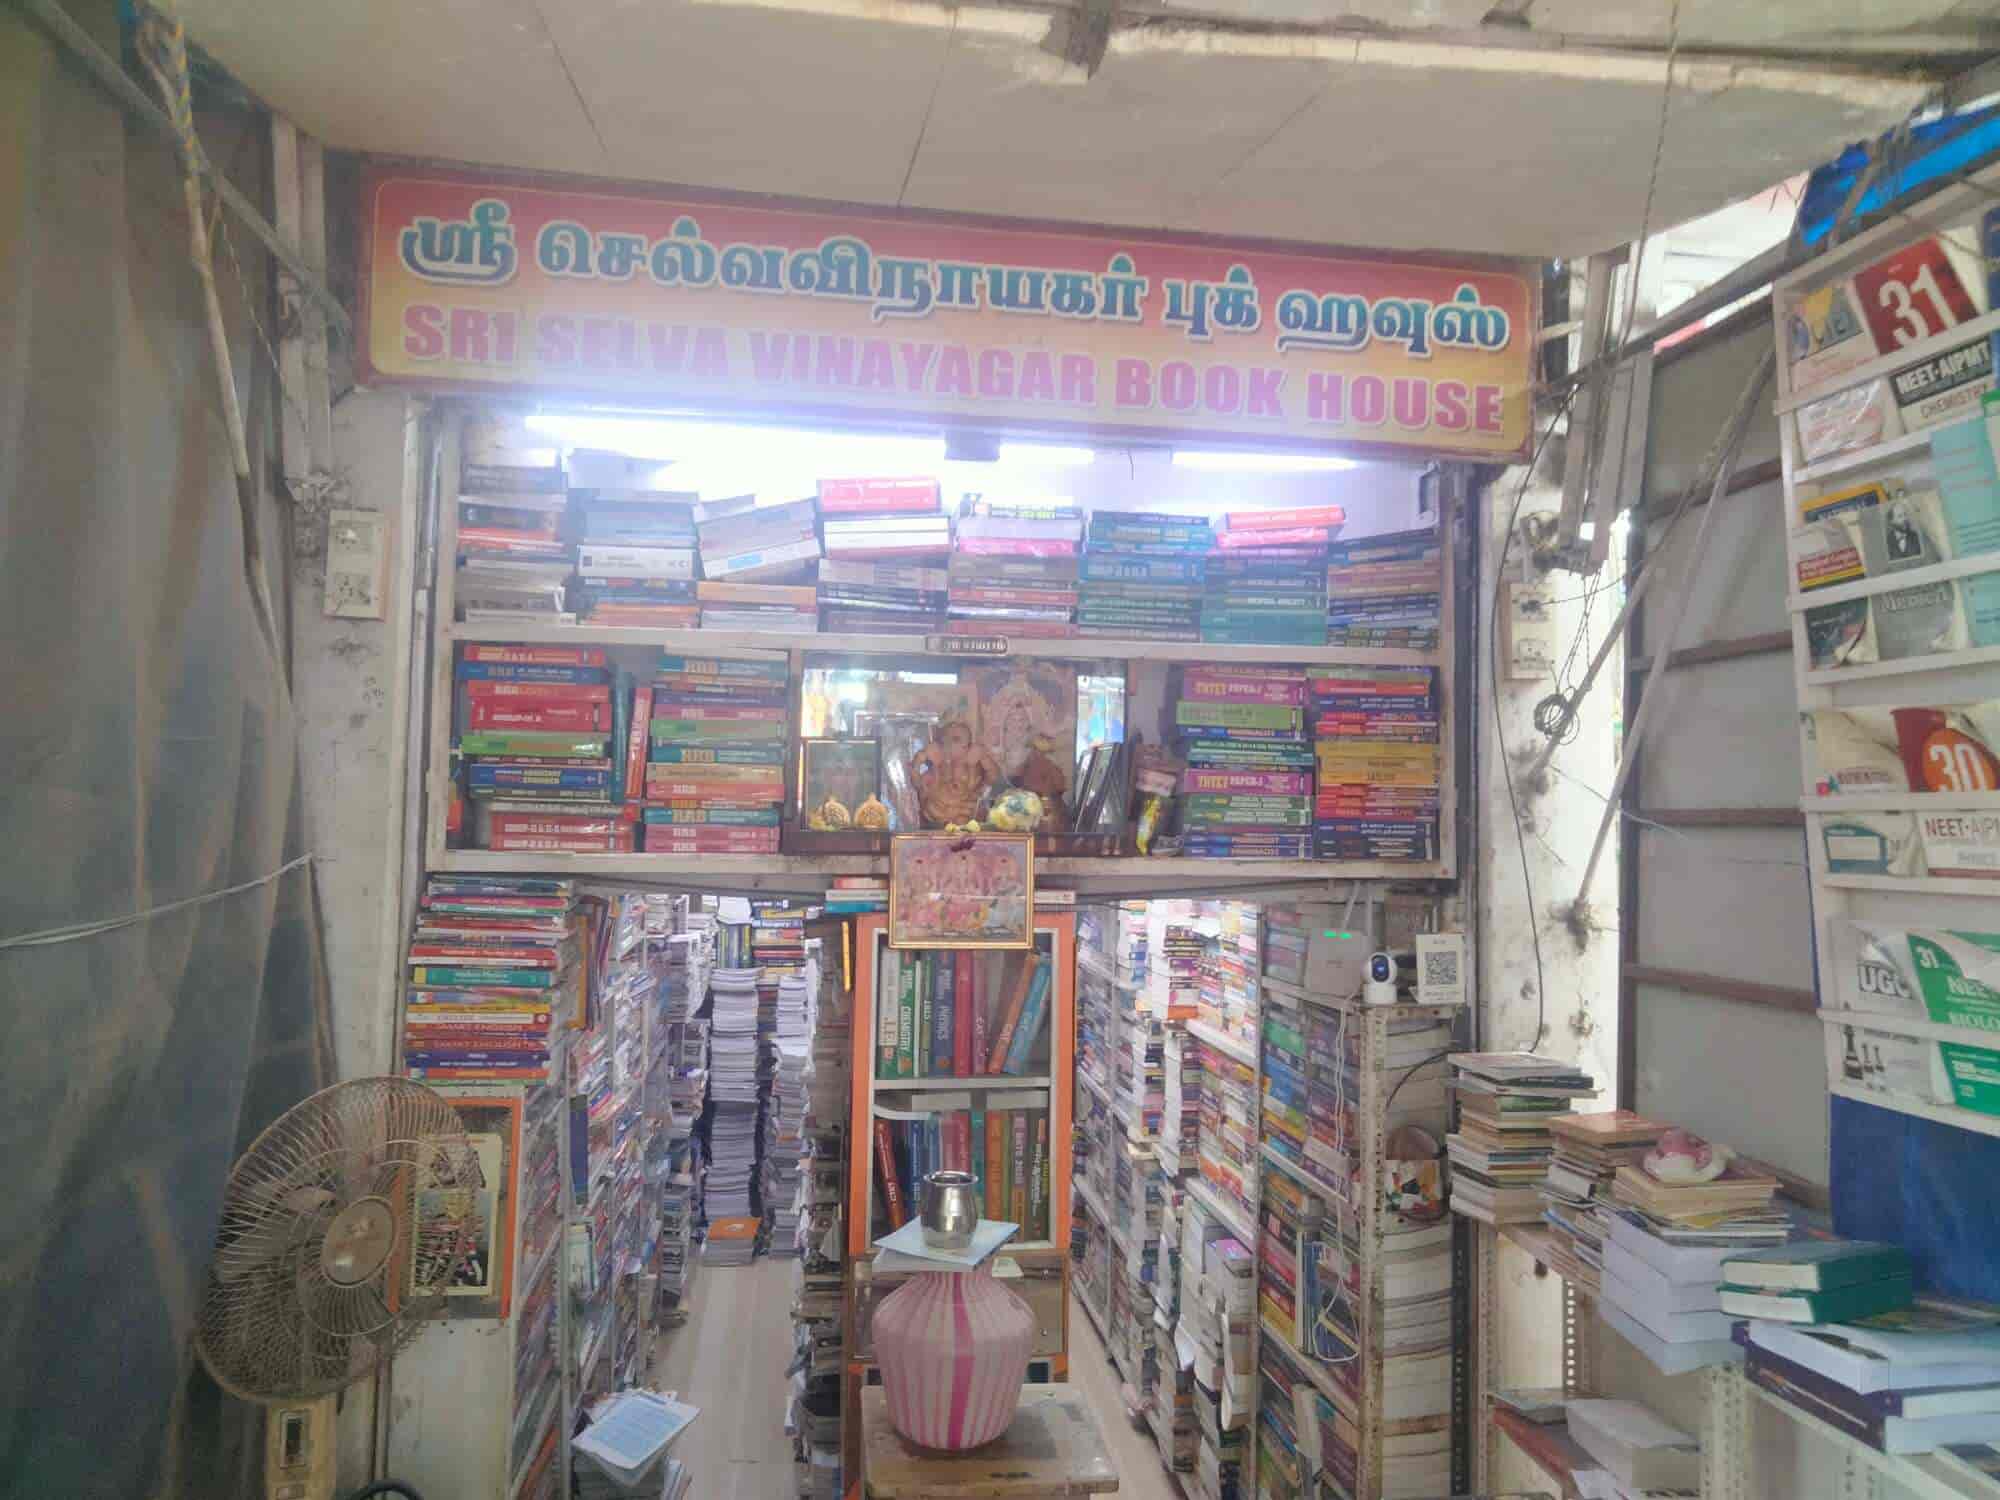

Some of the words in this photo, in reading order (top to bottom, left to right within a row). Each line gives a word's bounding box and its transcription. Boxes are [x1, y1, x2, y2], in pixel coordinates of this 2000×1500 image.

[538, 216, 1148, 322] செல்வவிநாயகர்
[1162, 263, 1259, 338] புக்
[1276, 284, 1510, 358] ஹவுஸ்
[1879, 263, 1957, 346] 31
[403, 304, 517, 363] SRI
[538, 315, 730, 377] SELVA
[748, 332, 1096, 406] VINAYAGAR
[1115, 358, 1287, 419] BOOK
[1306, 372, 1505, 433] HOUSE
